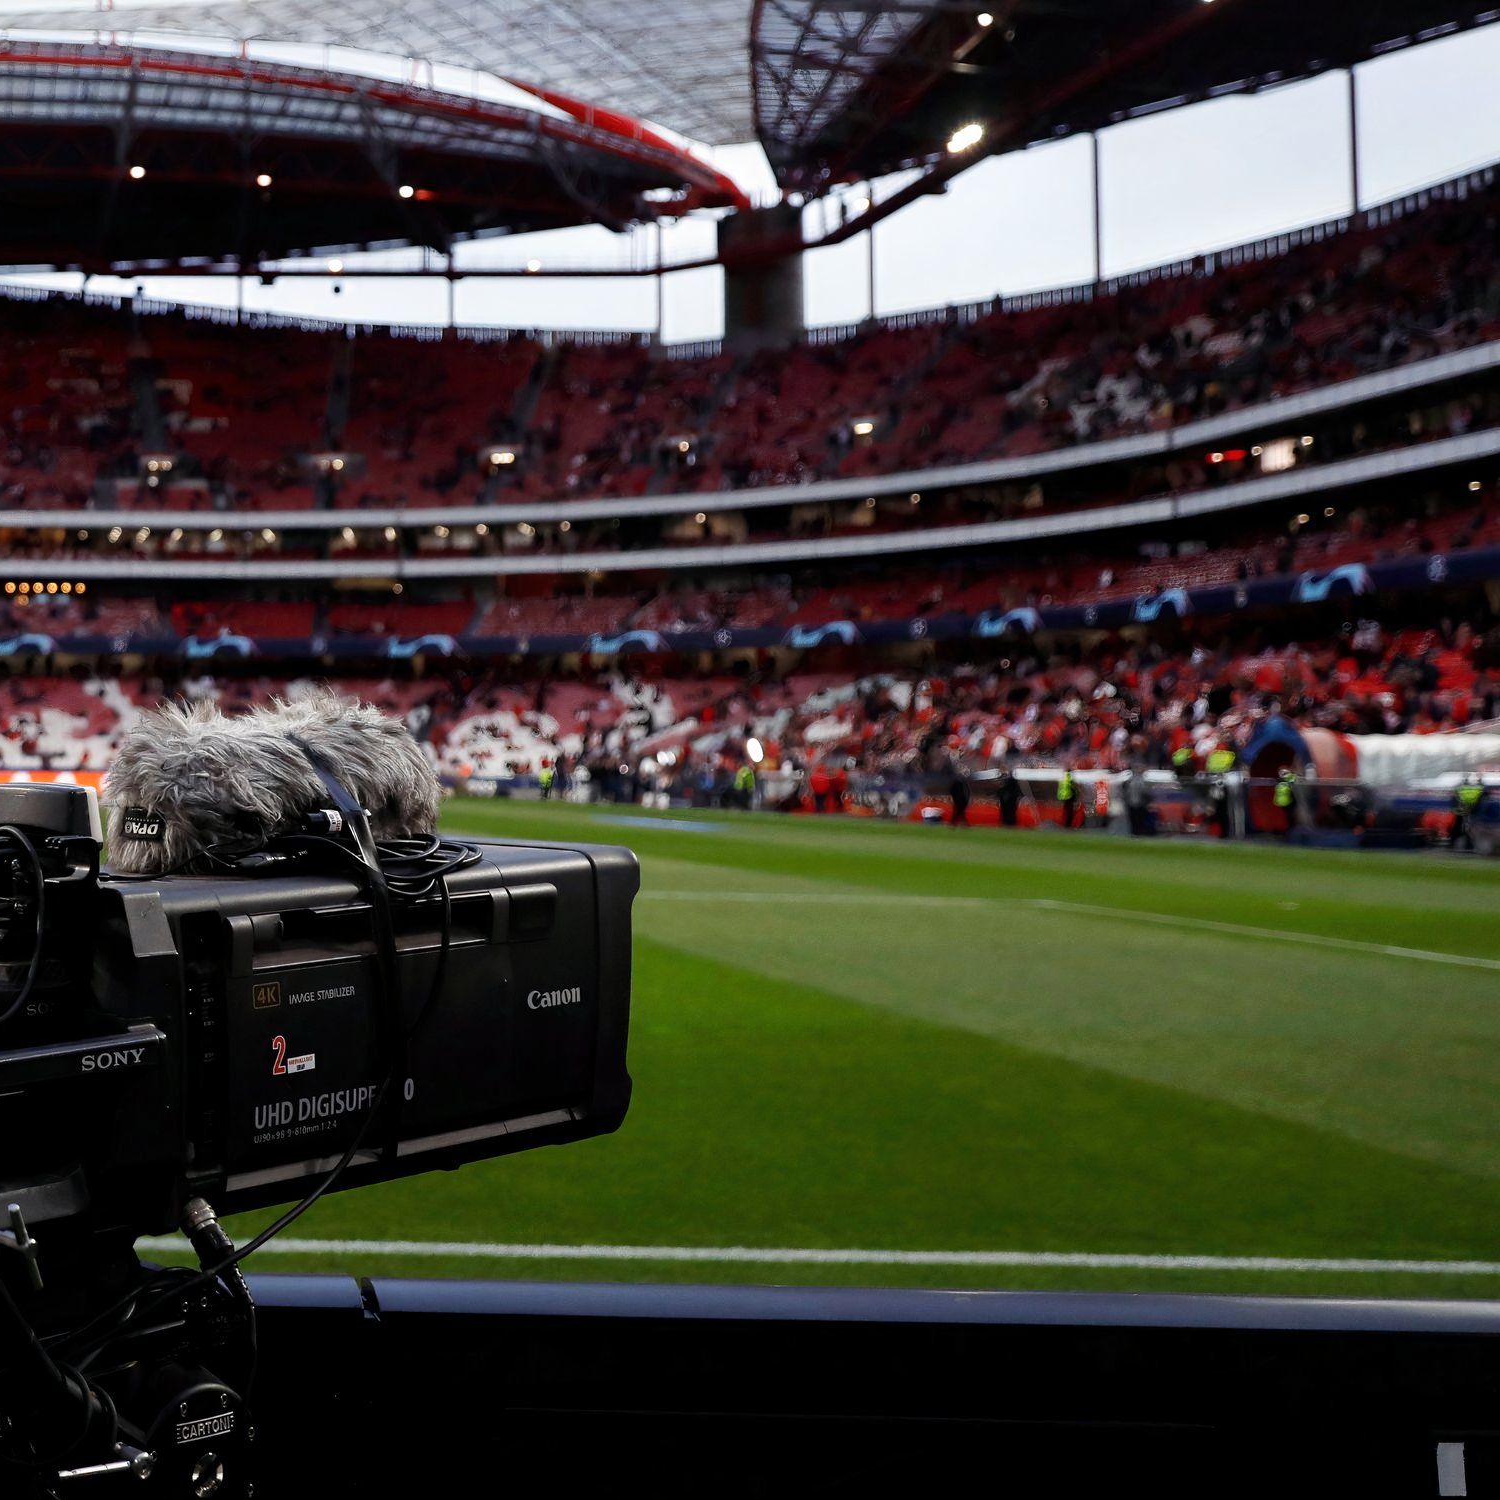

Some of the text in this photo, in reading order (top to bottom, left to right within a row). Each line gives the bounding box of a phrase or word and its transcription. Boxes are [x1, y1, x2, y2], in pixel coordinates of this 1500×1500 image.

[132, 822, 159, 834] DPA
[257, 986, 356, 1005] 4K IMAGE STABILIZER
[527, 987, 580, 1009] Canon
[81, 1048, 145, 1071] SONY
[272, 1035, 286, 1075] 2
[254, 1100, 294, 1129] UHD
[181, 1415, 231, 1440] CARTONI
